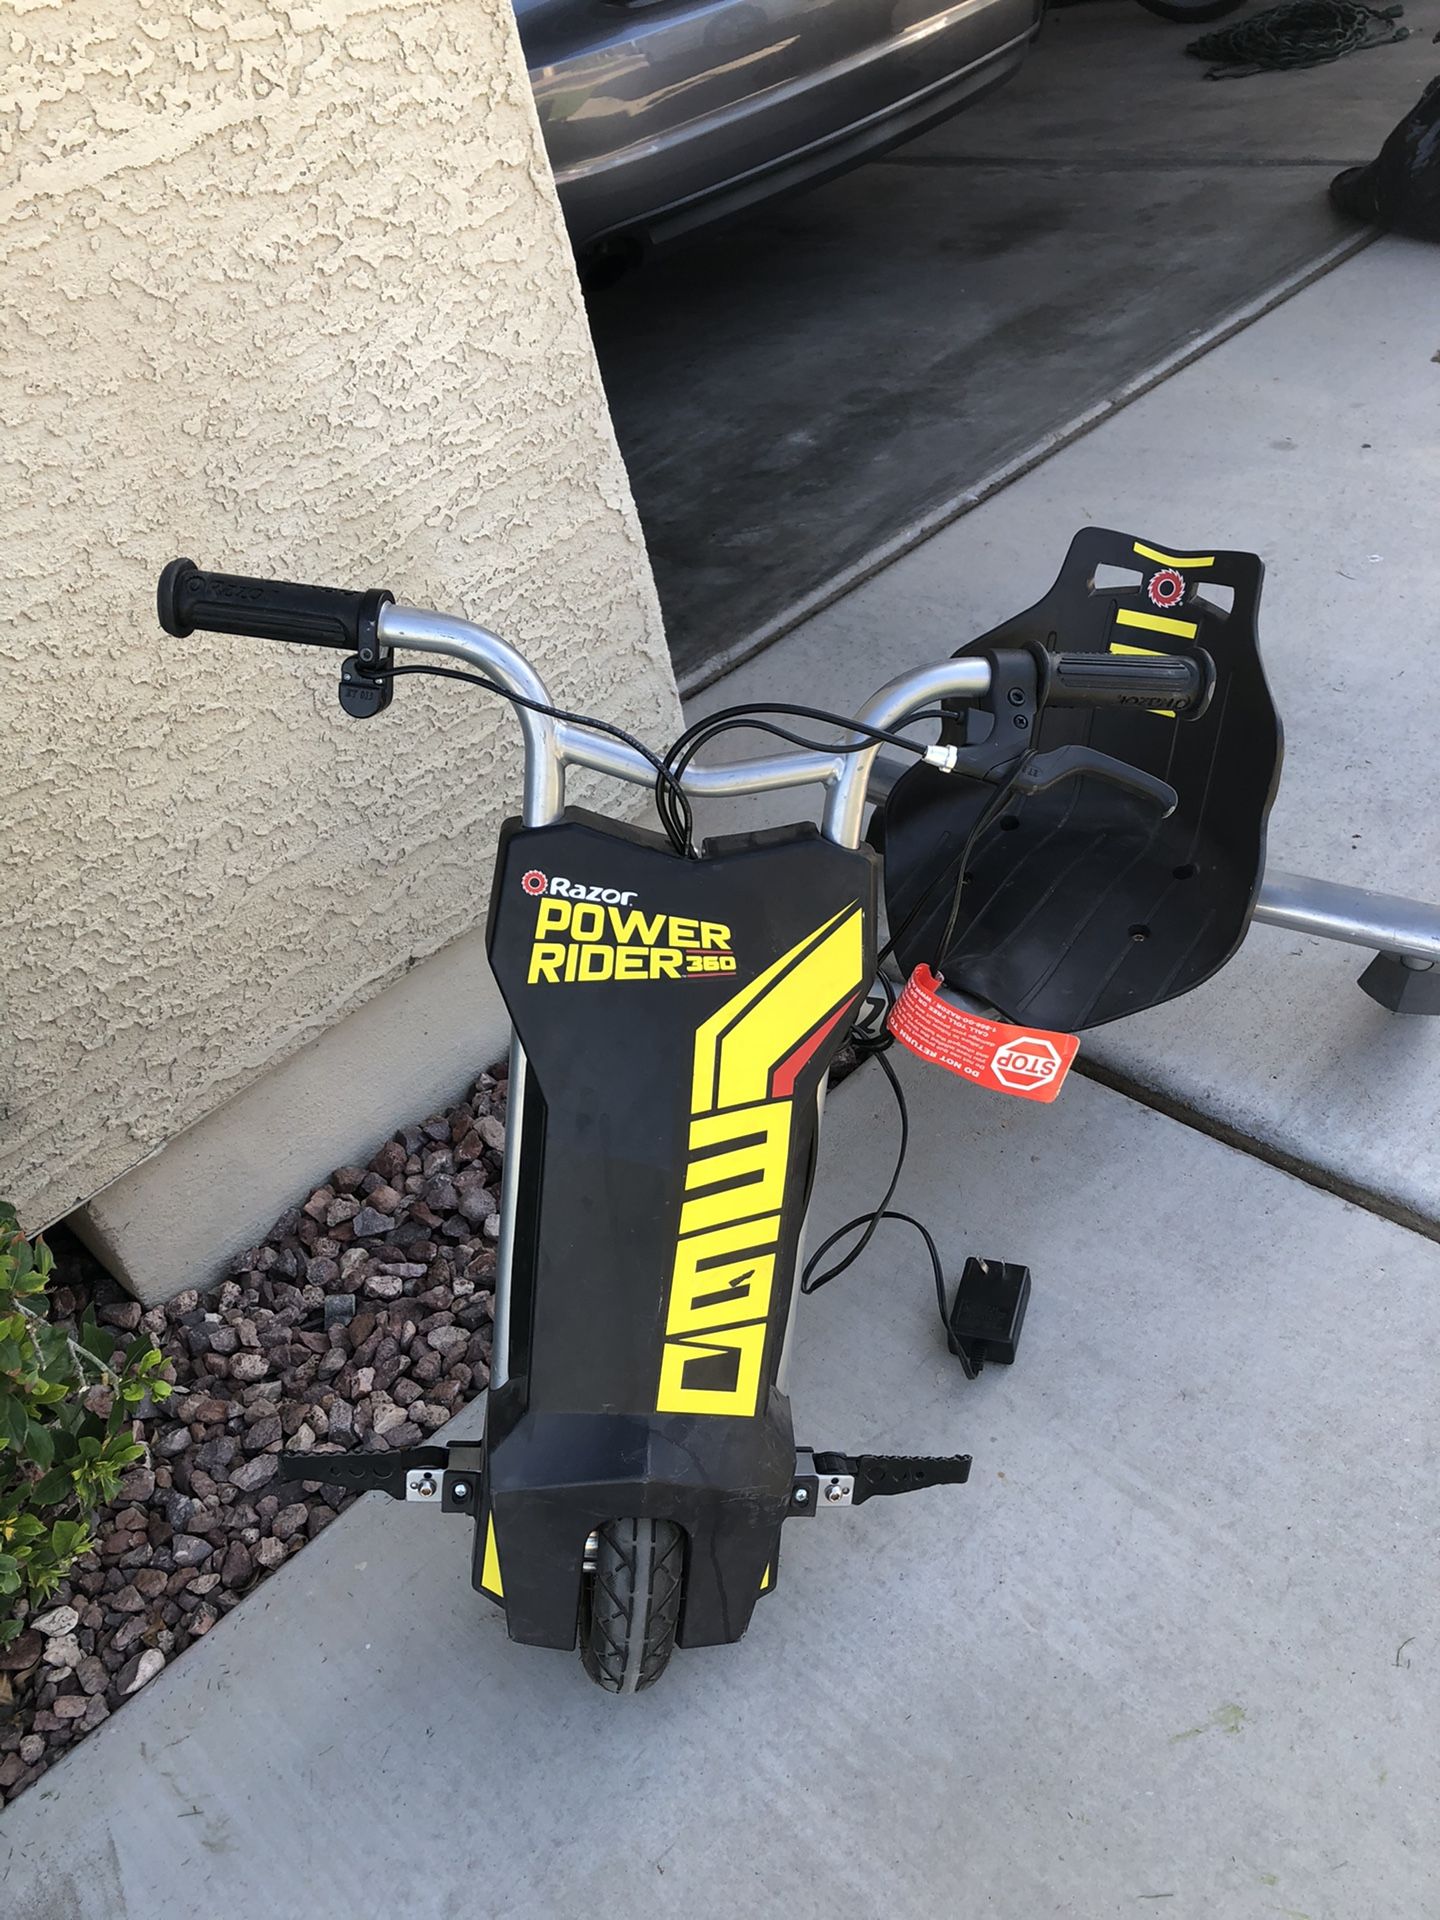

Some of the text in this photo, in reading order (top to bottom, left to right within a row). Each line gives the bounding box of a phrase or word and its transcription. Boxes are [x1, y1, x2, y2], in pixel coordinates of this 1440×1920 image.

[549, 876, 638, 906] Razor
[535, 897, 732, 949] POWER
[527, 942, 736, 984] RIDER 360
[928, 1006, 946, 1020] FREE
[948, 1017, 966, 1029] TOLL
[969, 1026, 988, 1037] CALL
[890, 1017, 980, 1078] DO NOT RETURN TO
[996, 1053, 1056, 1076] STOP
